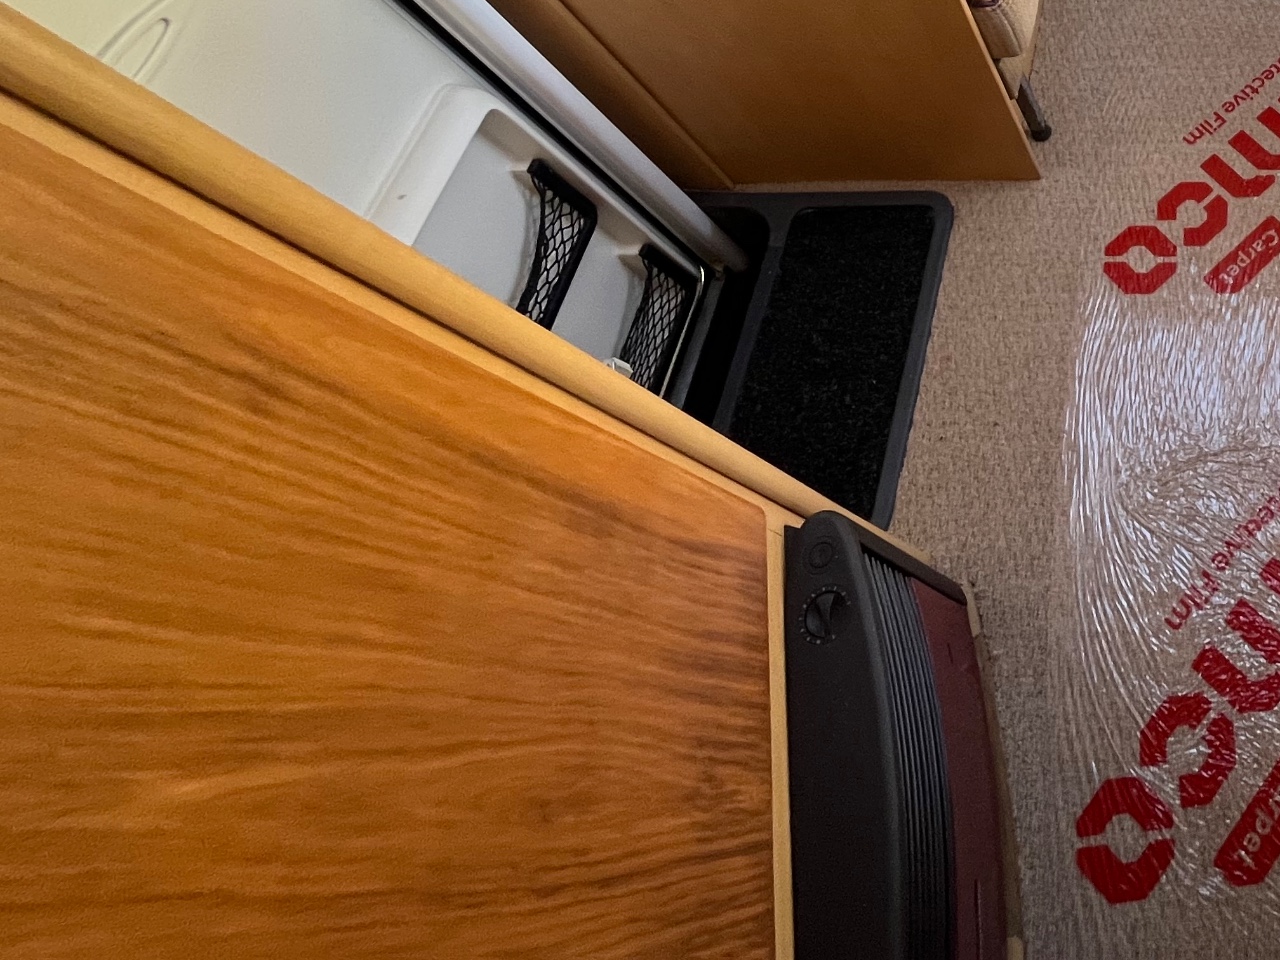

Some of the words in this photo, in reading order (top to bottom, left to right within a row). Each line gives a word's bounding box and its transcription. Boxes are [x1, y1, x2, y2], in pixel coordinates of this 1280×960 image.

[1183, 111, 1227, 145] Film
[1219, 229, 1279, 285] Carpet
[1164, 569, 1221, 630] Film
